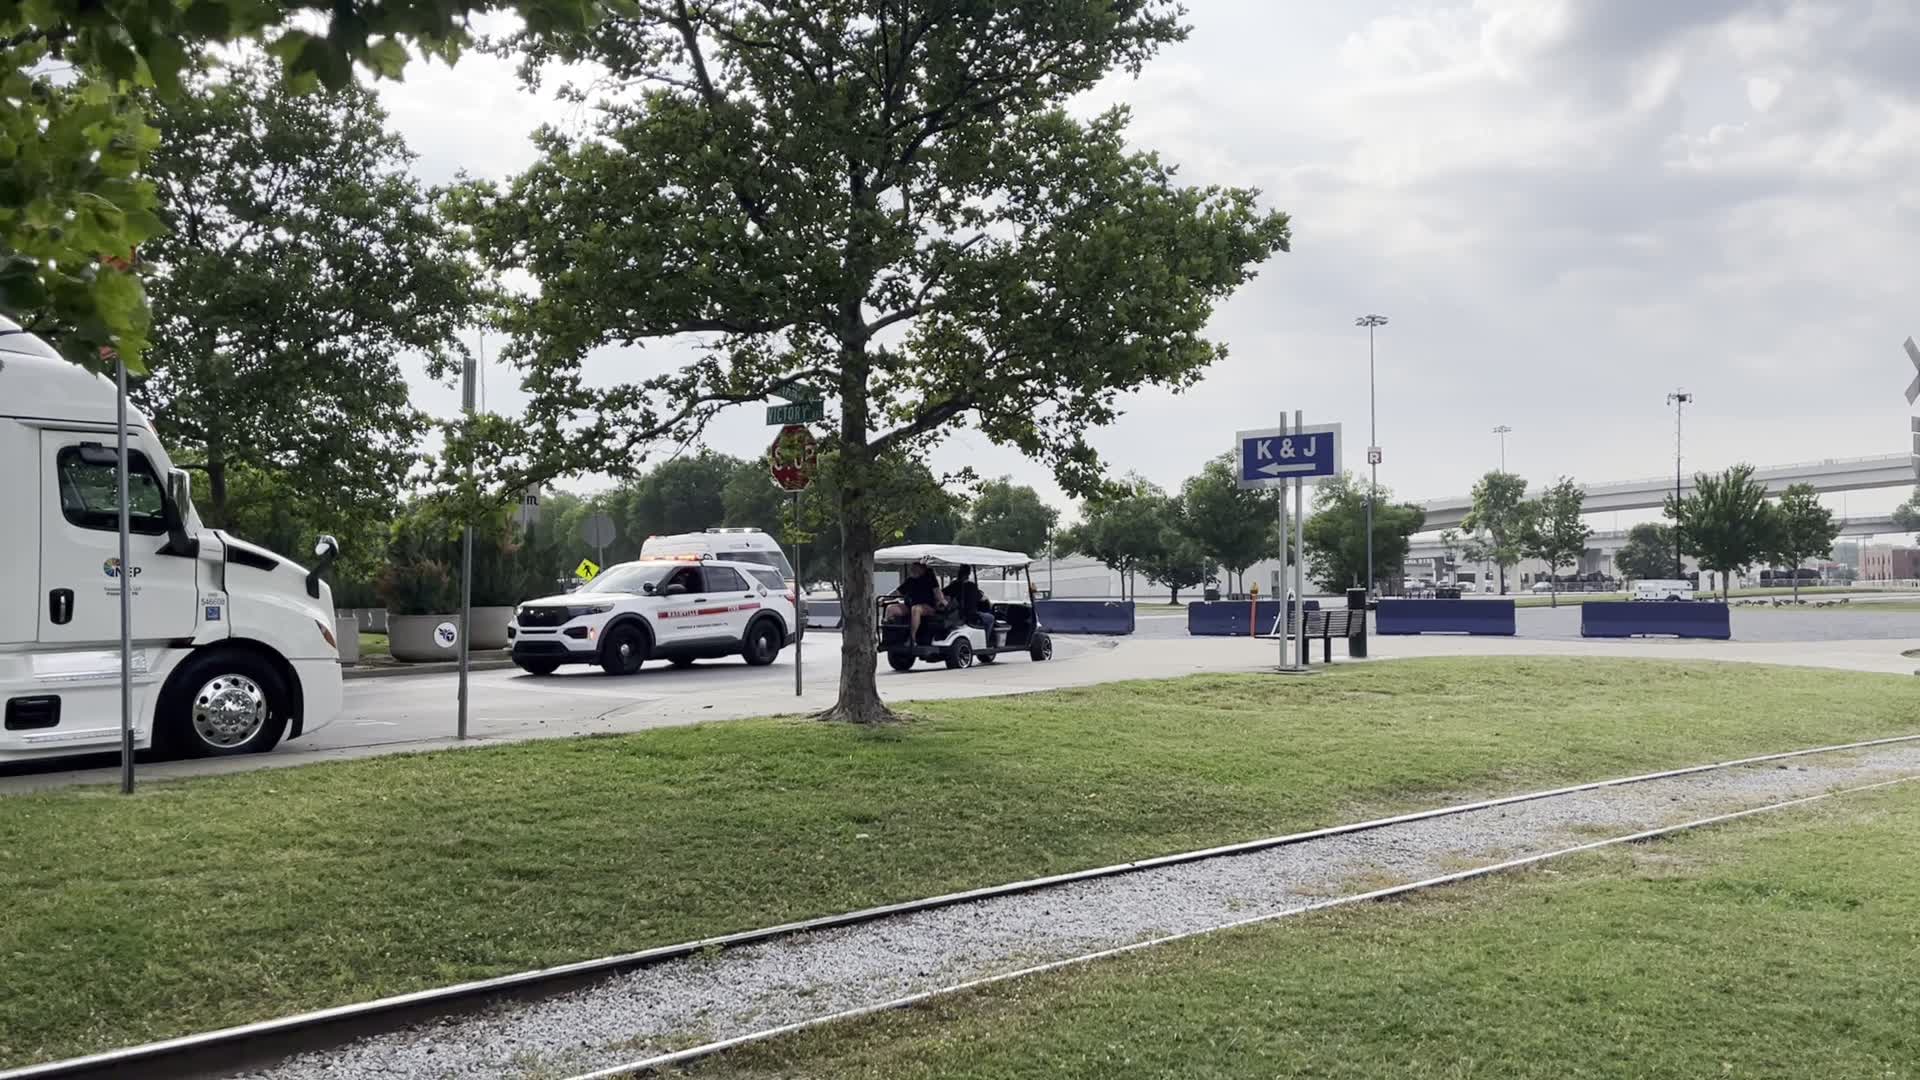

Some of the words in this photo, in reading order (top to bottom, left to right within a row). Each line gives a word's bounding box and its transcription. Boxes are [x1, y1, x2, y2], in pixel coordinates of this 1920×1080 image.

[767, 404, 807, 423] VICTORY
[1257, 439, 1272, 459] K
[1280, 438, 1296, 457] &
[1304, 437, 1316, 456] J
[1369, 452, 1380, 463] R
